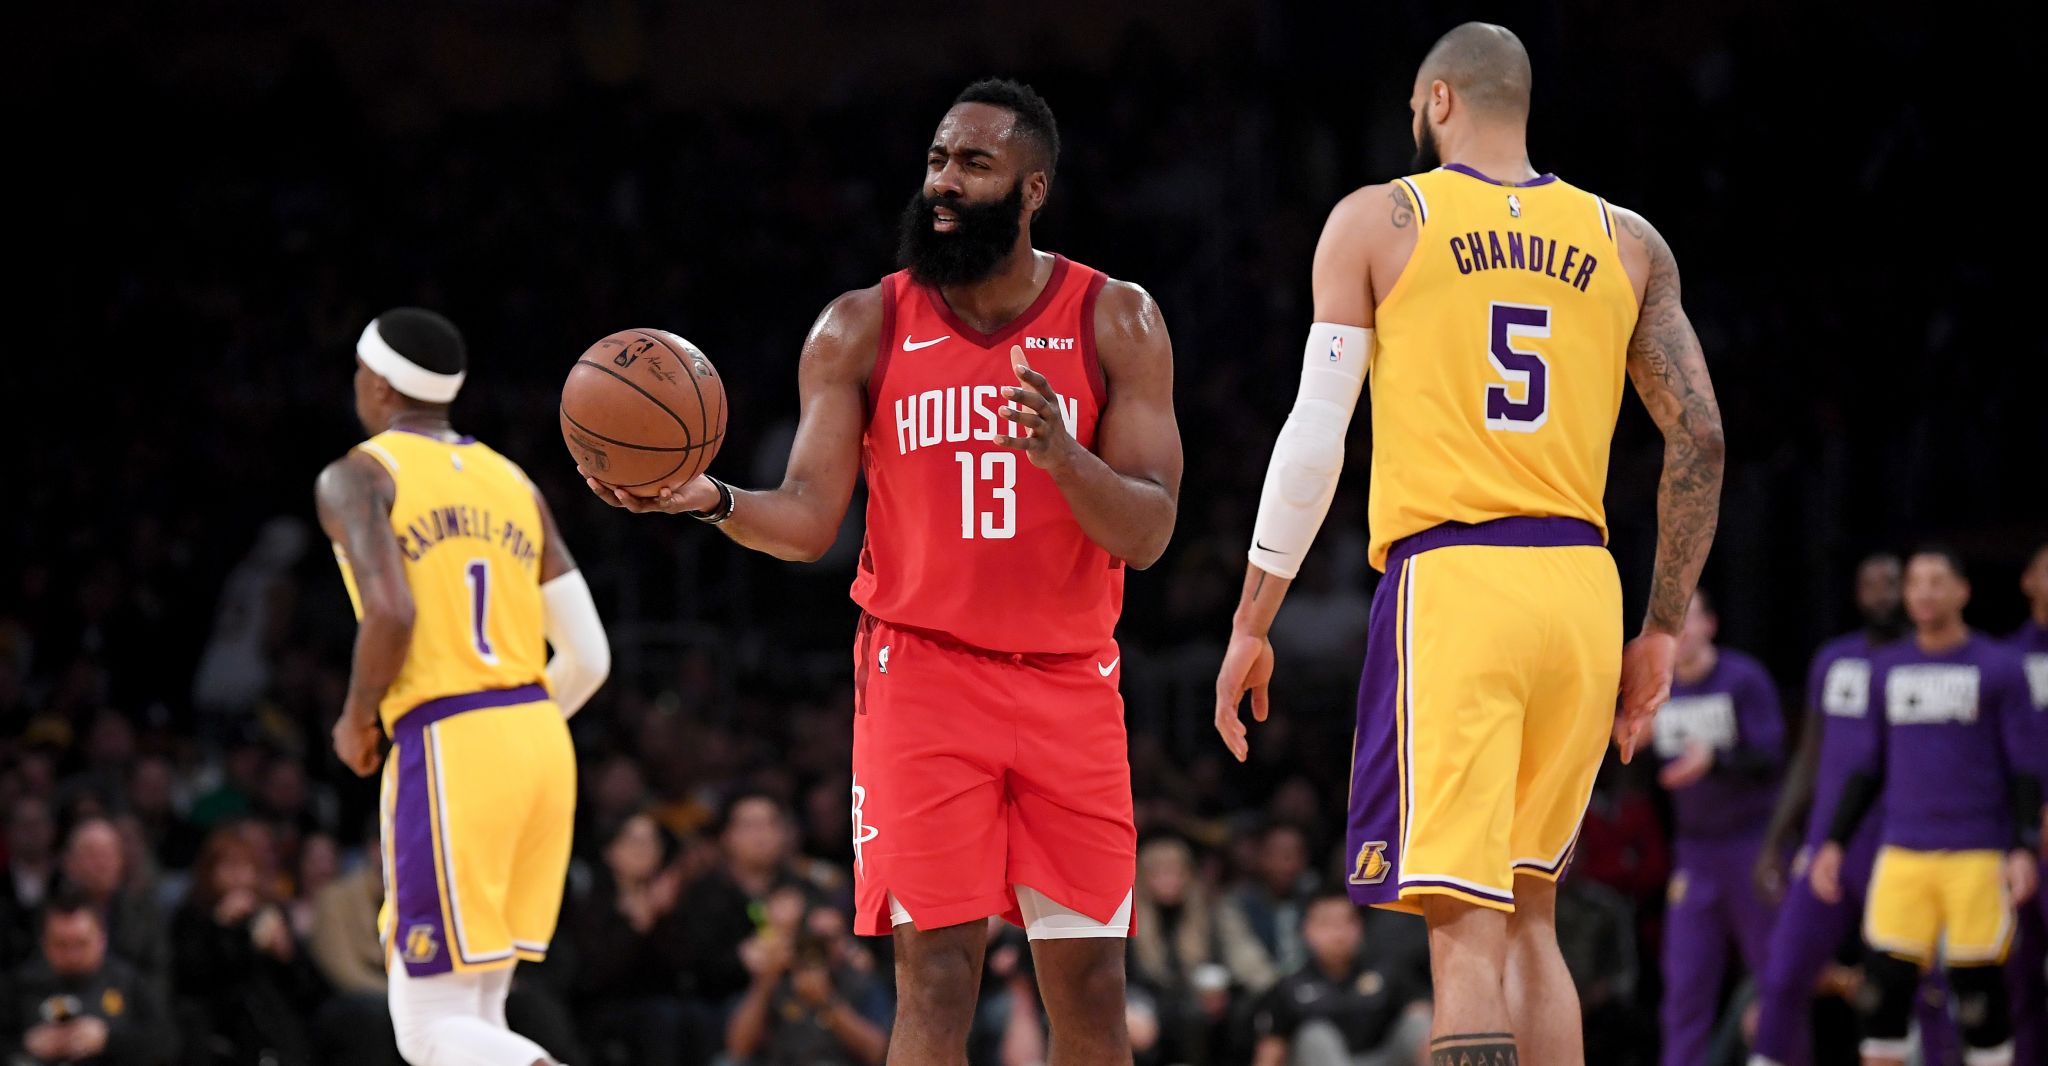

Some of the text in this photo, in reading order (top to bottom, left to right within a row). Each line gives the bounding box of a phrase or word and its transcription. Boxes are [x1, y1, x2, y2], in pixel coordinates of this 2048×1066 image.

[1450, 231, 1597, 292] CHANDLER
[1485, 301, 1551, 432] 5
[955, 452, 1016, 539] 13
[466, 558, 499, 665] 1
